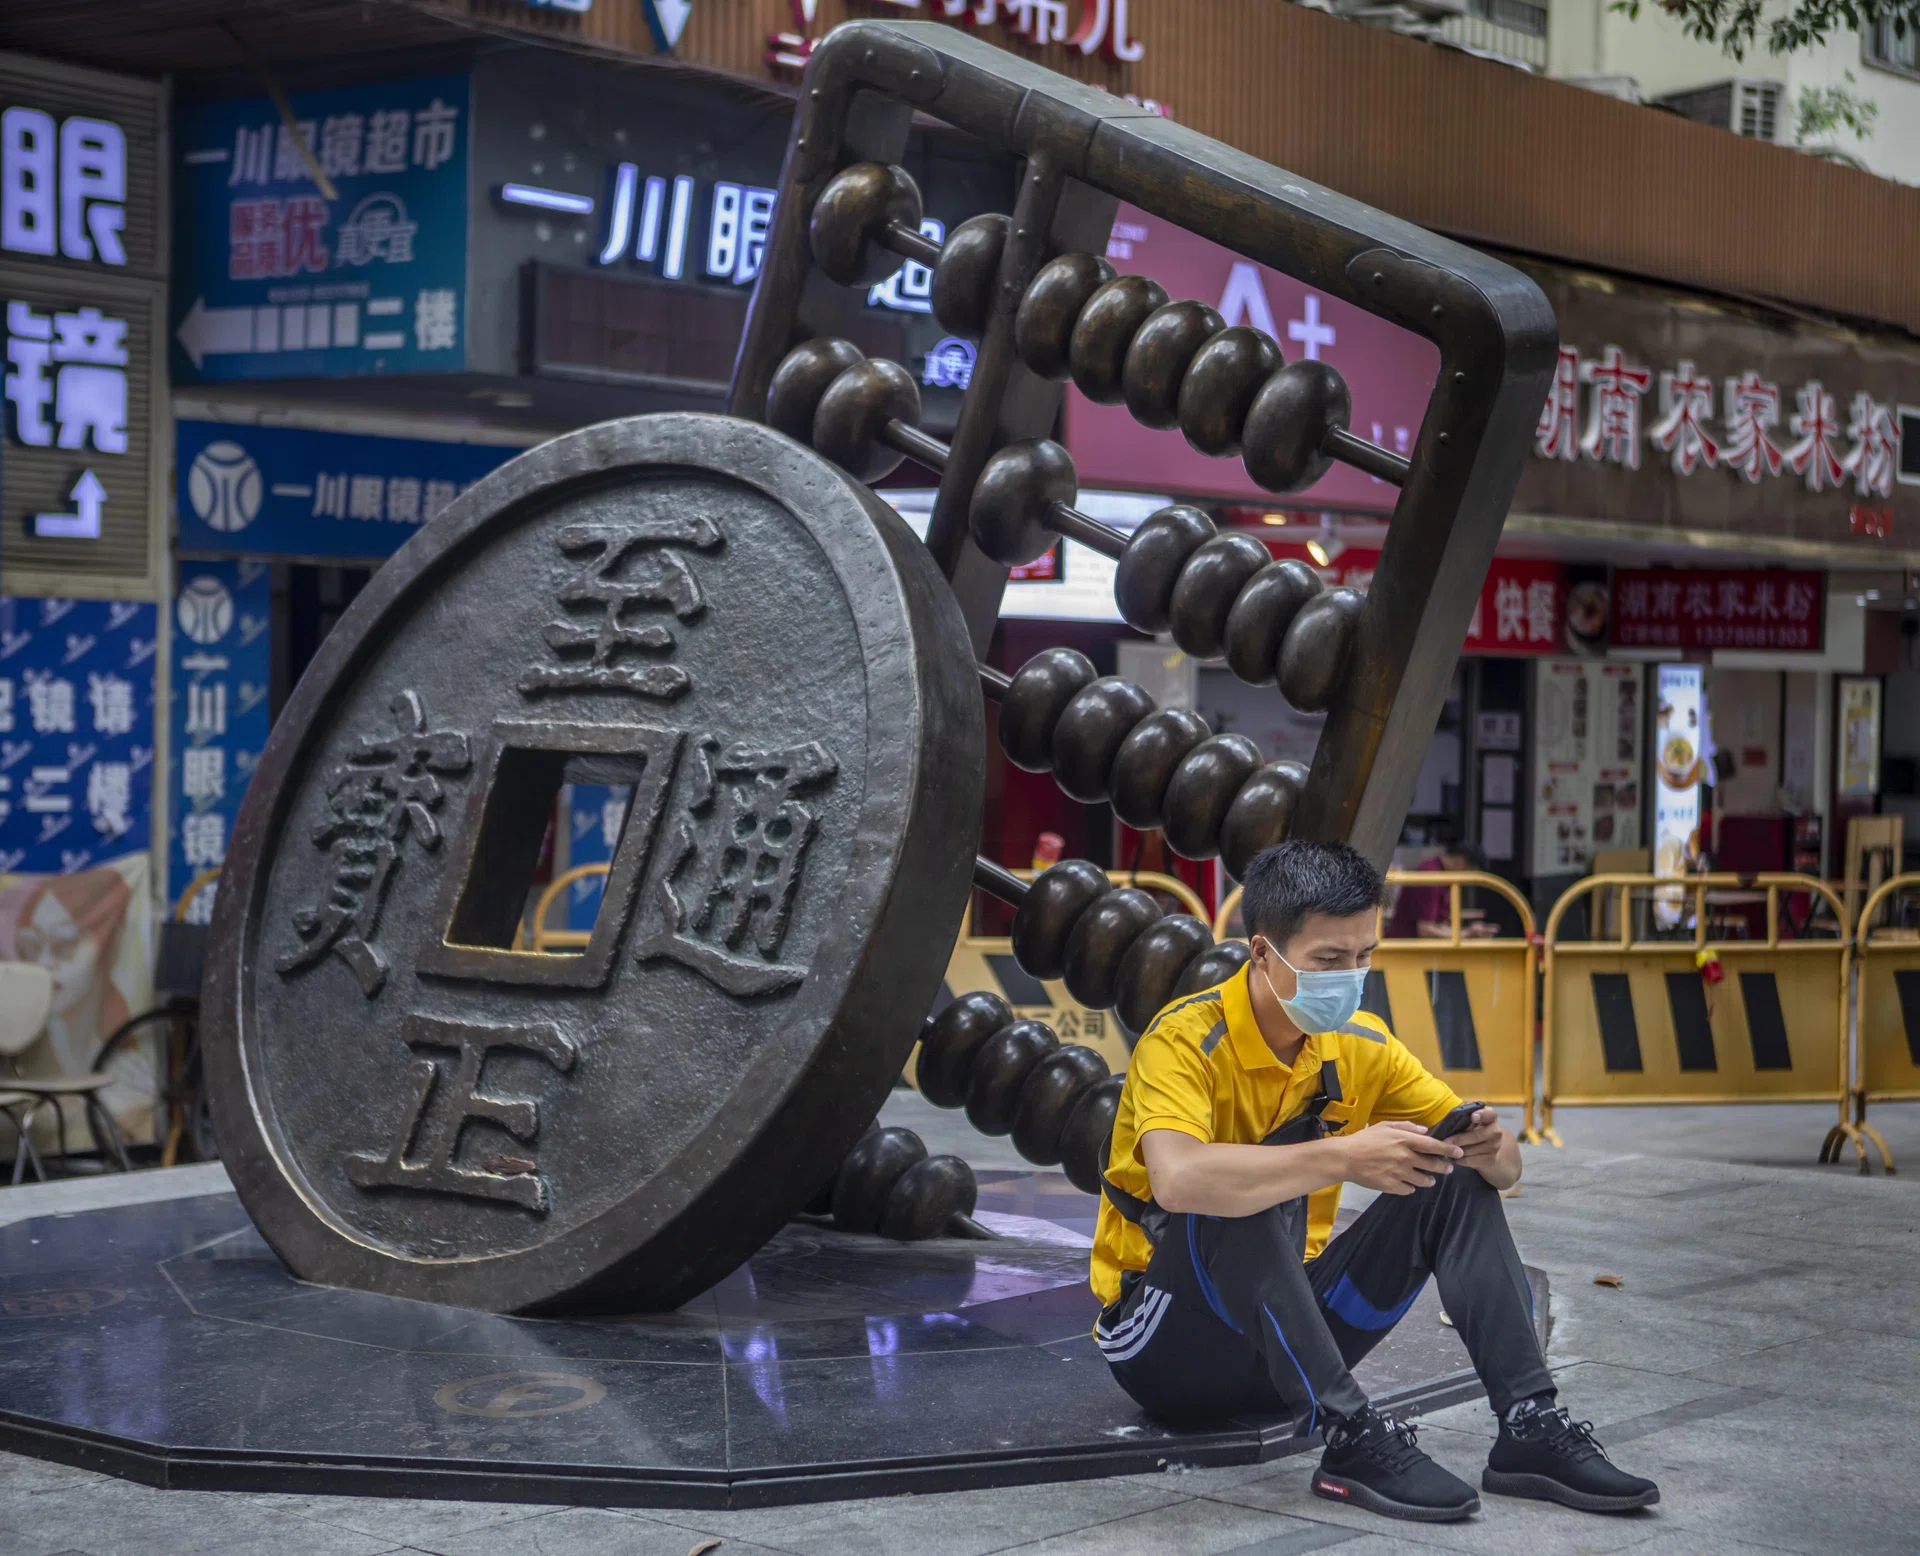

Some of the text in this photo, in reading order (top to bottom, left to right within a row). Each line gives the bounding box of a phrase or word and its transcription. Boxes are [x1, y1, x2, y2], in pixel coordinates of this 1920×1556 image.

[184, 98, 458, 187] 一川眼镜超市
[282, 196, 329, 273] 优
[363, 290, 456, 351] 二楼
[271, 472, 482, 523] 一川眼镜超
[517, 515, 726, 699] 至
[1466, 576, 1556, 642] 快餐
[1618, 579, 1815, 622] 湖南农家米粉
[0, 672, 134, 734] 镜请
[0, 763, 132, 836] 二楼
[634, 733, 839, 996] 通
[344, 1009, 577, 1214] 正
